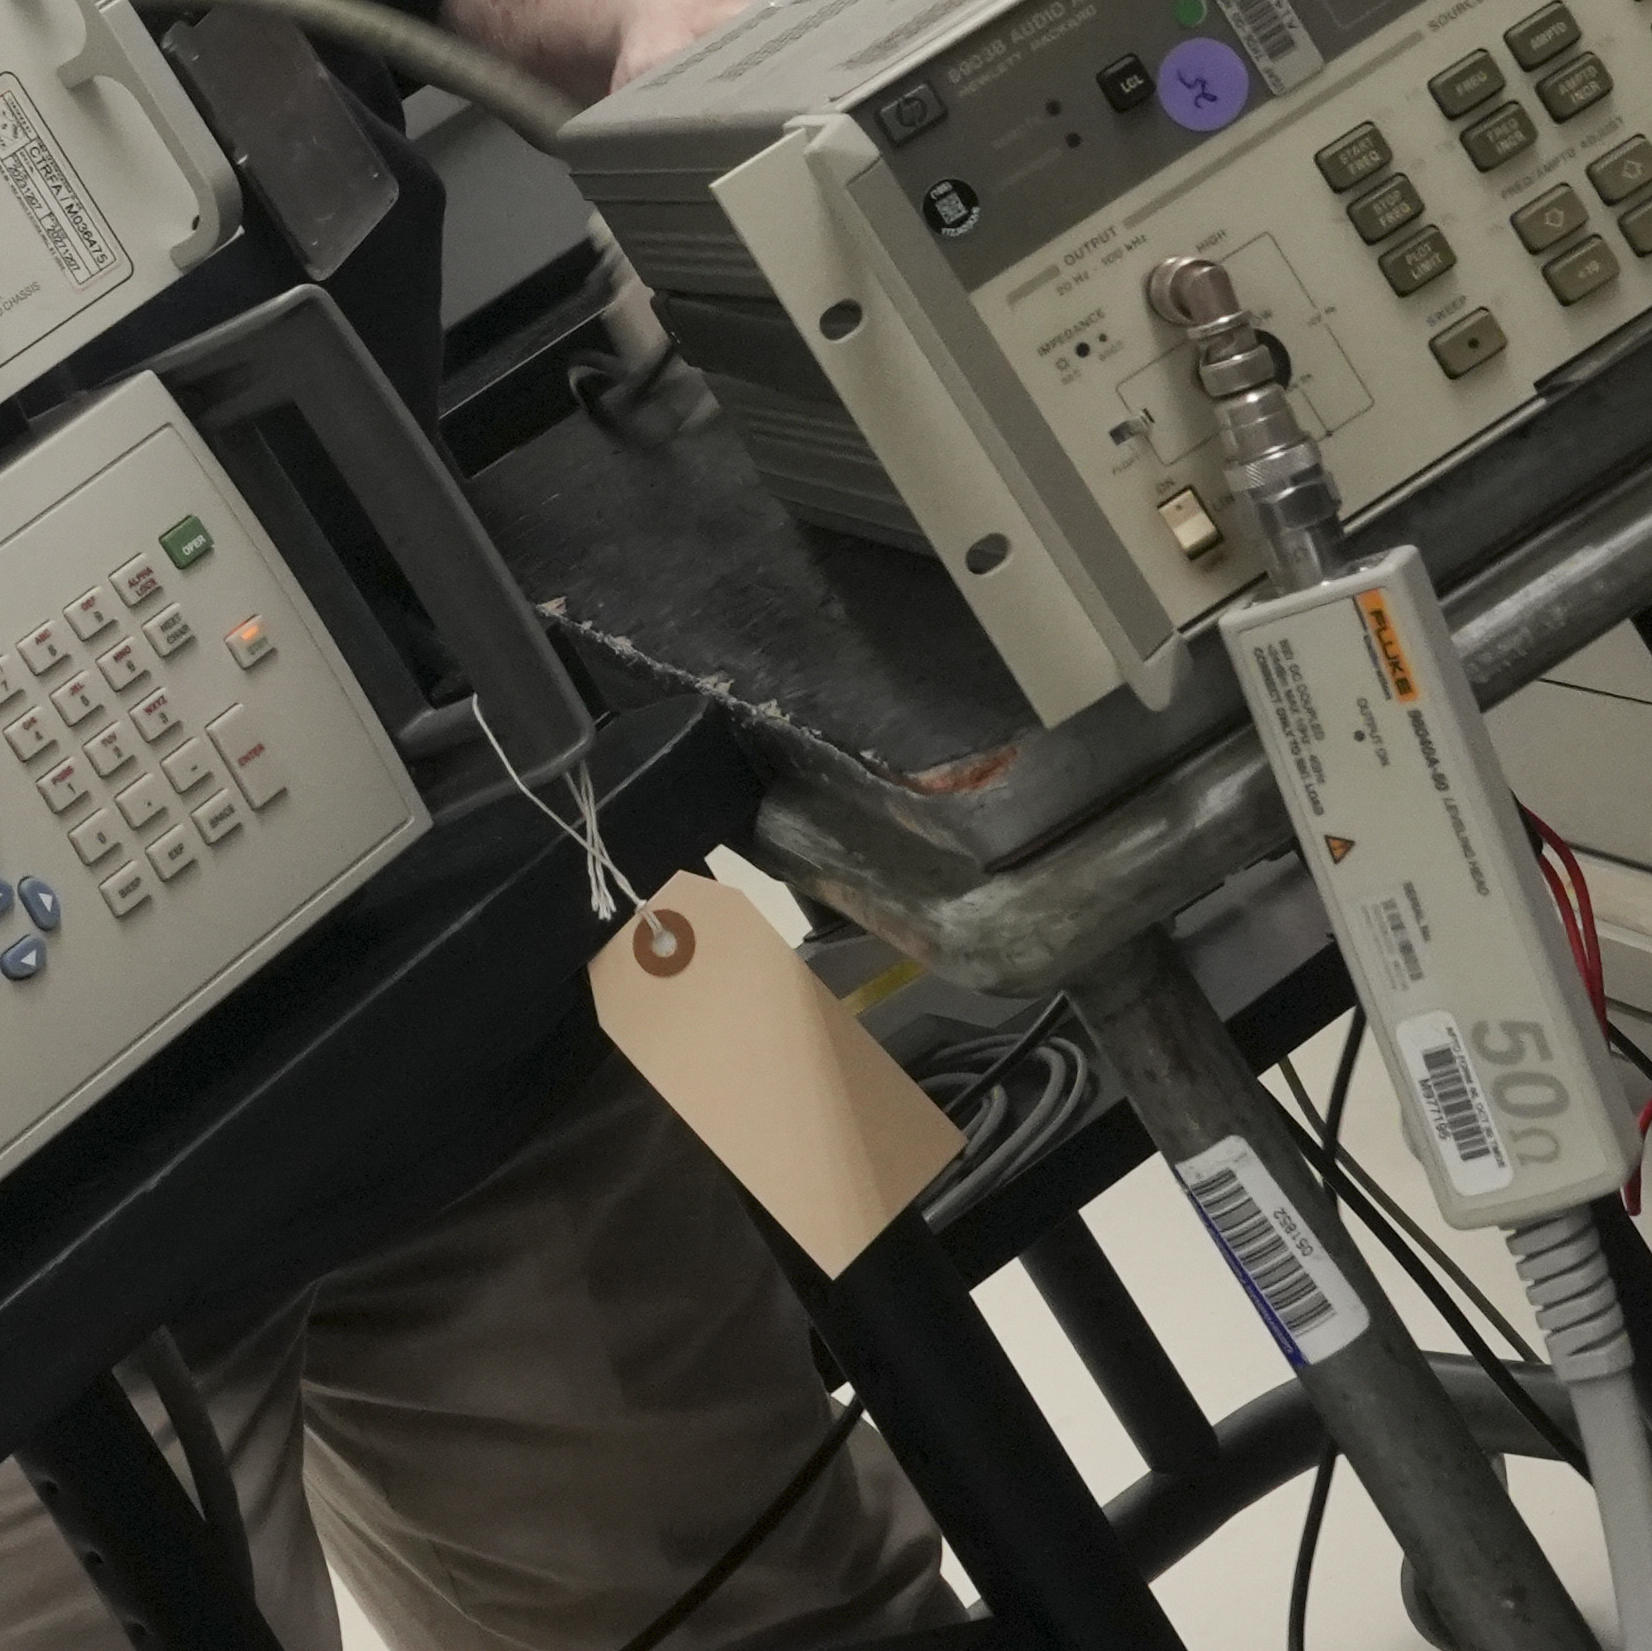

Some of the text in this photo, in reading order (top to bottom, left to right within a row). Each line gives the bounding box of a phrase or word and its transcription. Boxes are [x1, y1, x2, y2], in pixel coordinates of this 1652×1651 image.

[1005, 0, 1068, 46] AUDIO
[27, 144, 108, 265] CTRFA M036475
[1060, 224, 1122, 268] OUTPUT
[1033, 306, 1108, 358] IMPEDANCE
[180, 533, 208, 557] OPER
[125, 565, 155, 589] ALPHA
[1365, 607, 1414, 697] FLUKE
[1354, 696, 1384, 747] OUTPUT
[1271, 1204, 1315, 1259] 051852
